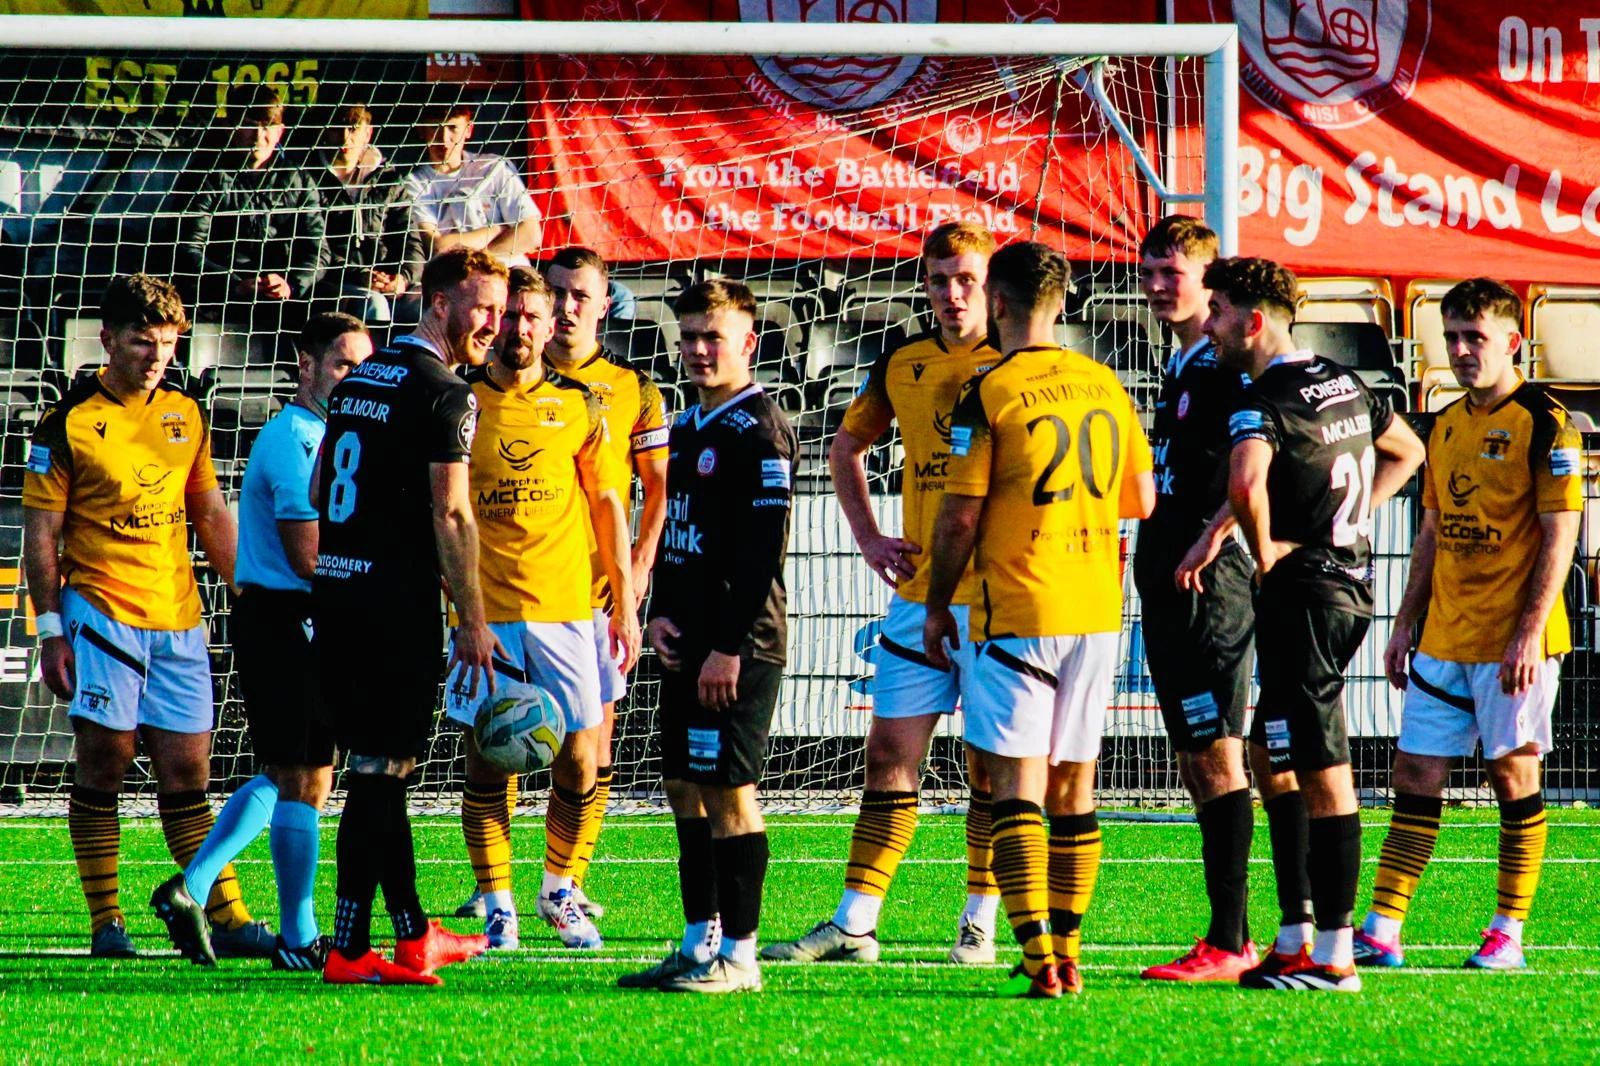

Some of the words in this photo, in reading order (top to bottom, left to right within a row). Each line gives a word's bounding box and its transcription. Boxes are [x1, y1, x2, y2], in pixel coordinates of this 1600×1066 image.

[1498, 16, 1563, 83] On
[1303, 104, 1341, 123] NISI
[659, 157, 757, 187] From
[766, 158, 825, 187] the
[835, 157, 1020, 192] Battlefield
[1237, 146, 1324, 247] Big
[1344, 151, 1522, 229] Stand
[661, 205, 695, 232] to
[706, 202, 762, 231] the
[771, 201, 918, 232] Football
[351, 361, 409, 383] OWERAIR
[340, 397, 390, 423] GILMOUR
[1019, 384, 1112, 408] DAVIDSON
[1026, 408, 1119, 507] 20
[328, 431, 361, 523] 8
[477, 487, 565, 506] McCosh
[1439, 522, 1502, 541] cCosh
